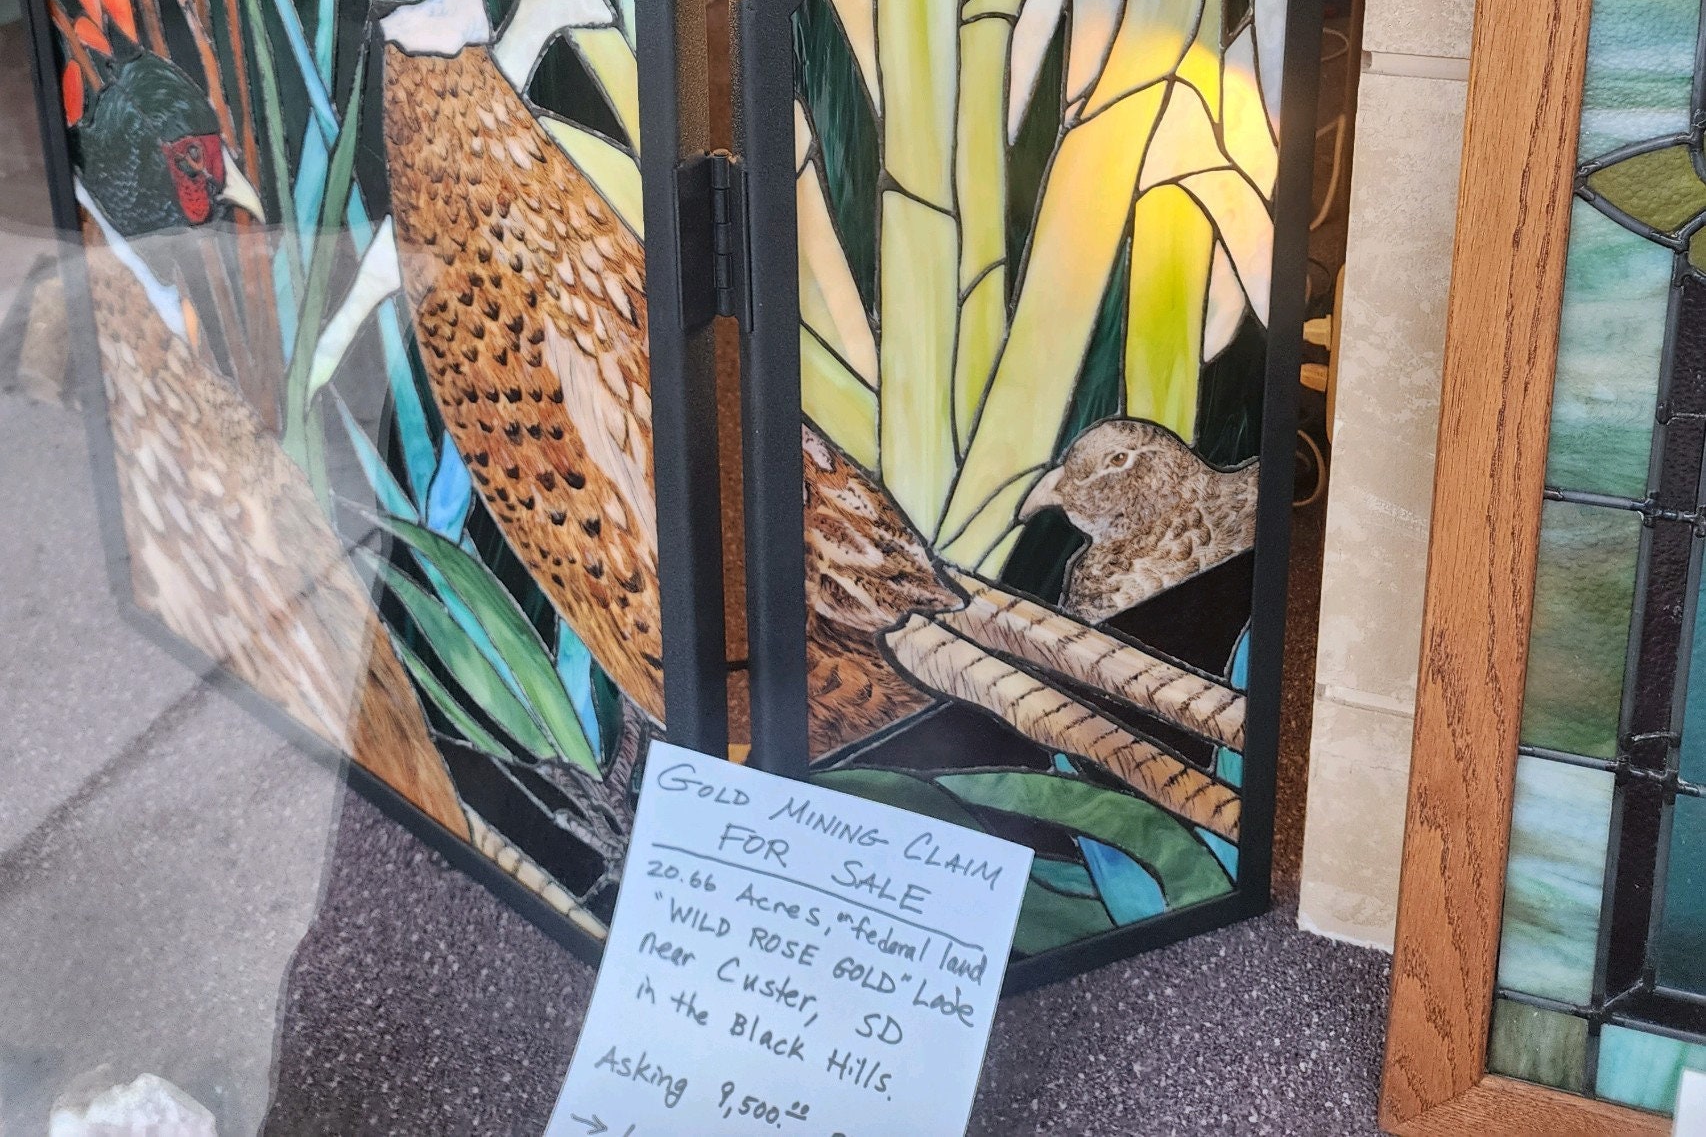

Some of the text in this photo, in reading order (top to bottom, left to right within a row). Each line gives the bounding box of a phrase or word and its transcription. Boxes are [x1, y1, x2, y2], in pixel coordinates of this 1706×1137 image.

[657, 763, 1003, 891] GOLD MINING CLAIM
[718, 823, 932, 915] FOR SALE
[647, 860, 717, 893] 20.66
[851, 916, 931, 962] federal
[939, 941, 988, 986] land
[750, 927, 820, 966] ROSE
[636, 975, 892, 1102] in the Black Hills.
[639, 931, 903, 1045] near Custer, SD
[594, 1046, 688, 1108] Asking
